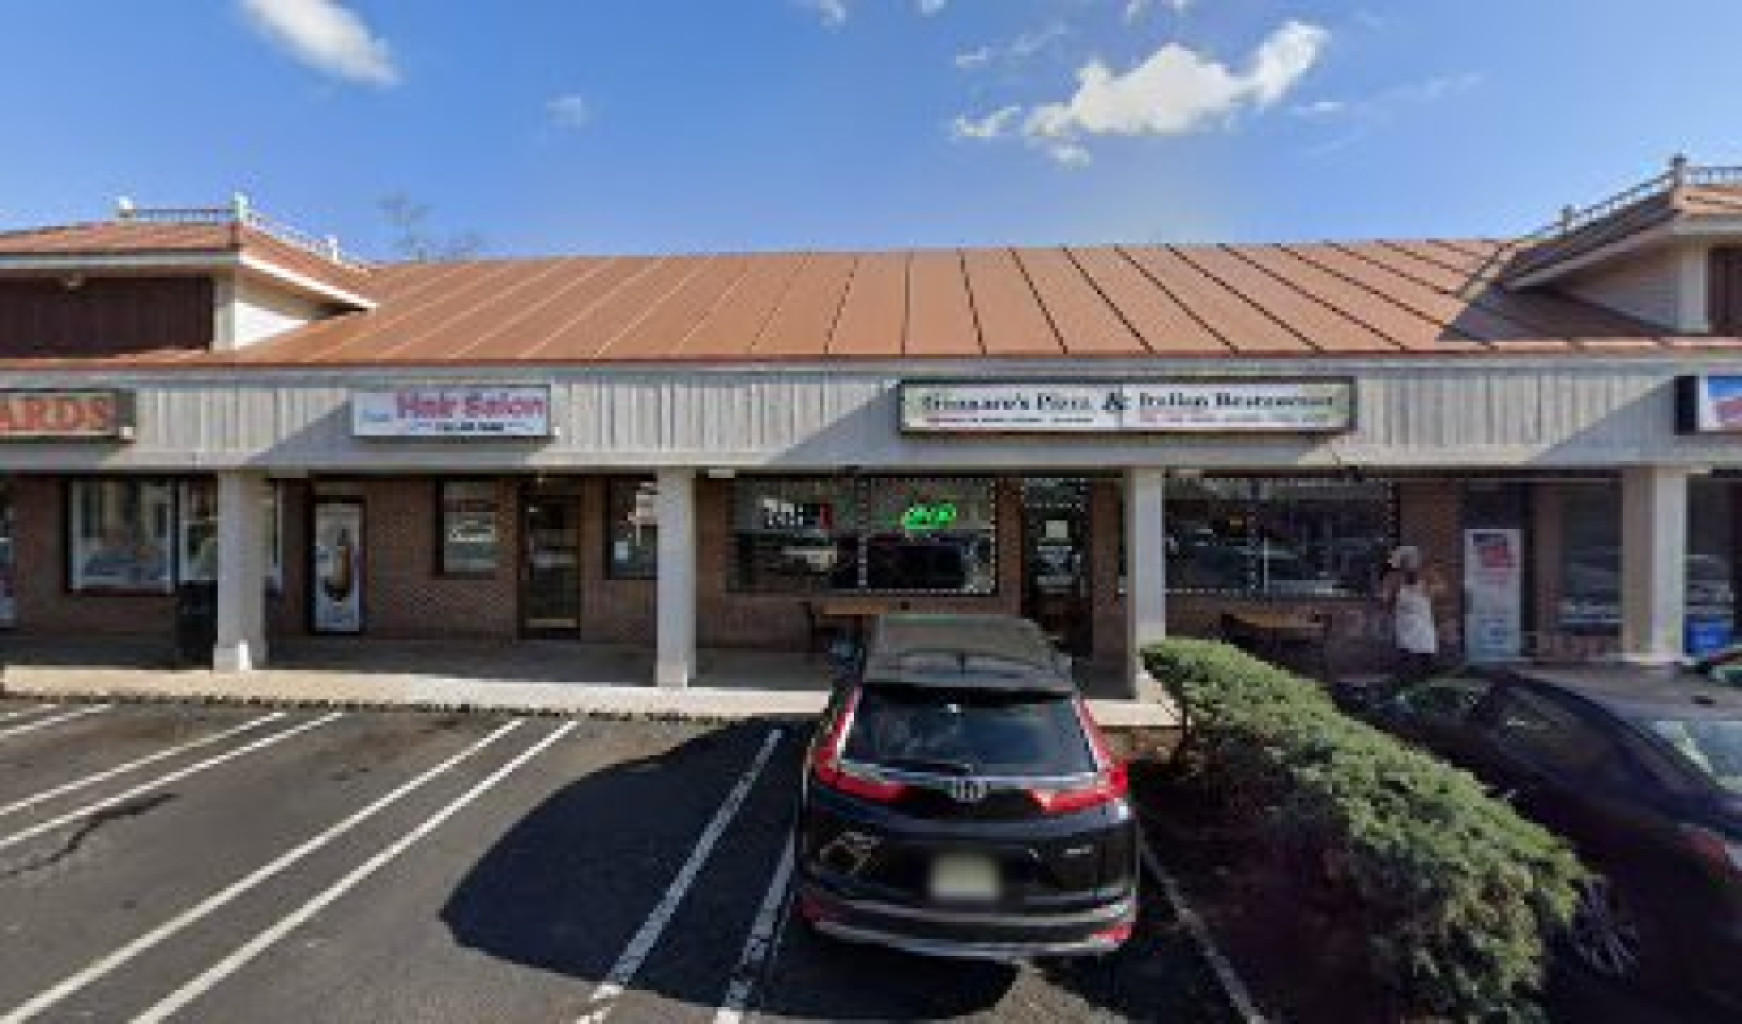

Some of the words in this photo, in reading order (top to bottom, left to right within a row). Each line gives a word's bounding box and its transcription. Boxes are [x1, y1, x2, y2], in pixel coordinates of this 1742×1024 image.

[394, 389, 457, 418] Hair
[465, 390, 545, 419] Salon
[1102, 391, 1129, 413] &
[1138, 392, 1209, 411] Italian
